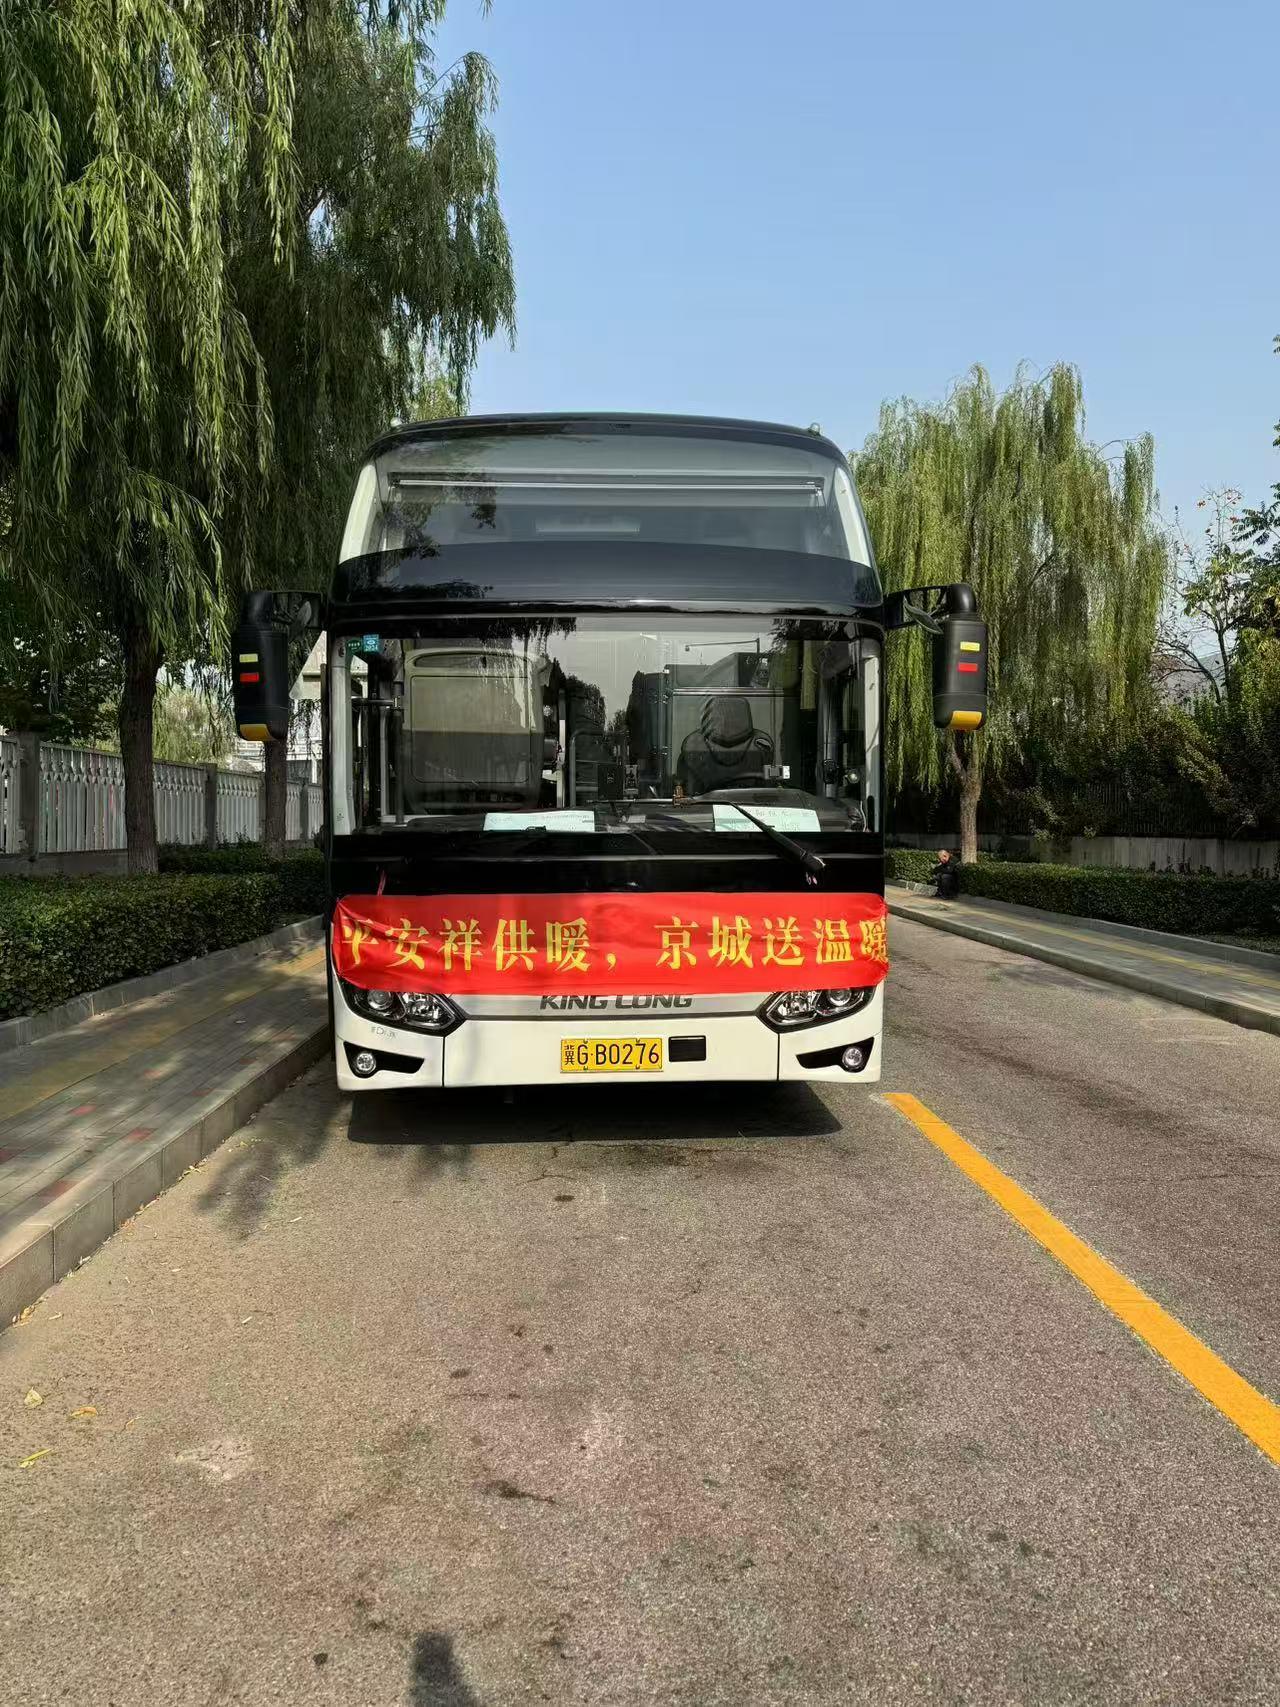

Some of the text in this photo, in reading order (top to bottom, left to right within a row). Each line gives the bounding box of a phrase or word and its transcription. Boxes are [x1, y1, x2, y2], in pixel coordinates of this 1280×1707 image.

[653, 915, 888, 970] 京城送温暖
[540, 993, 693, 1010] KING LONG
